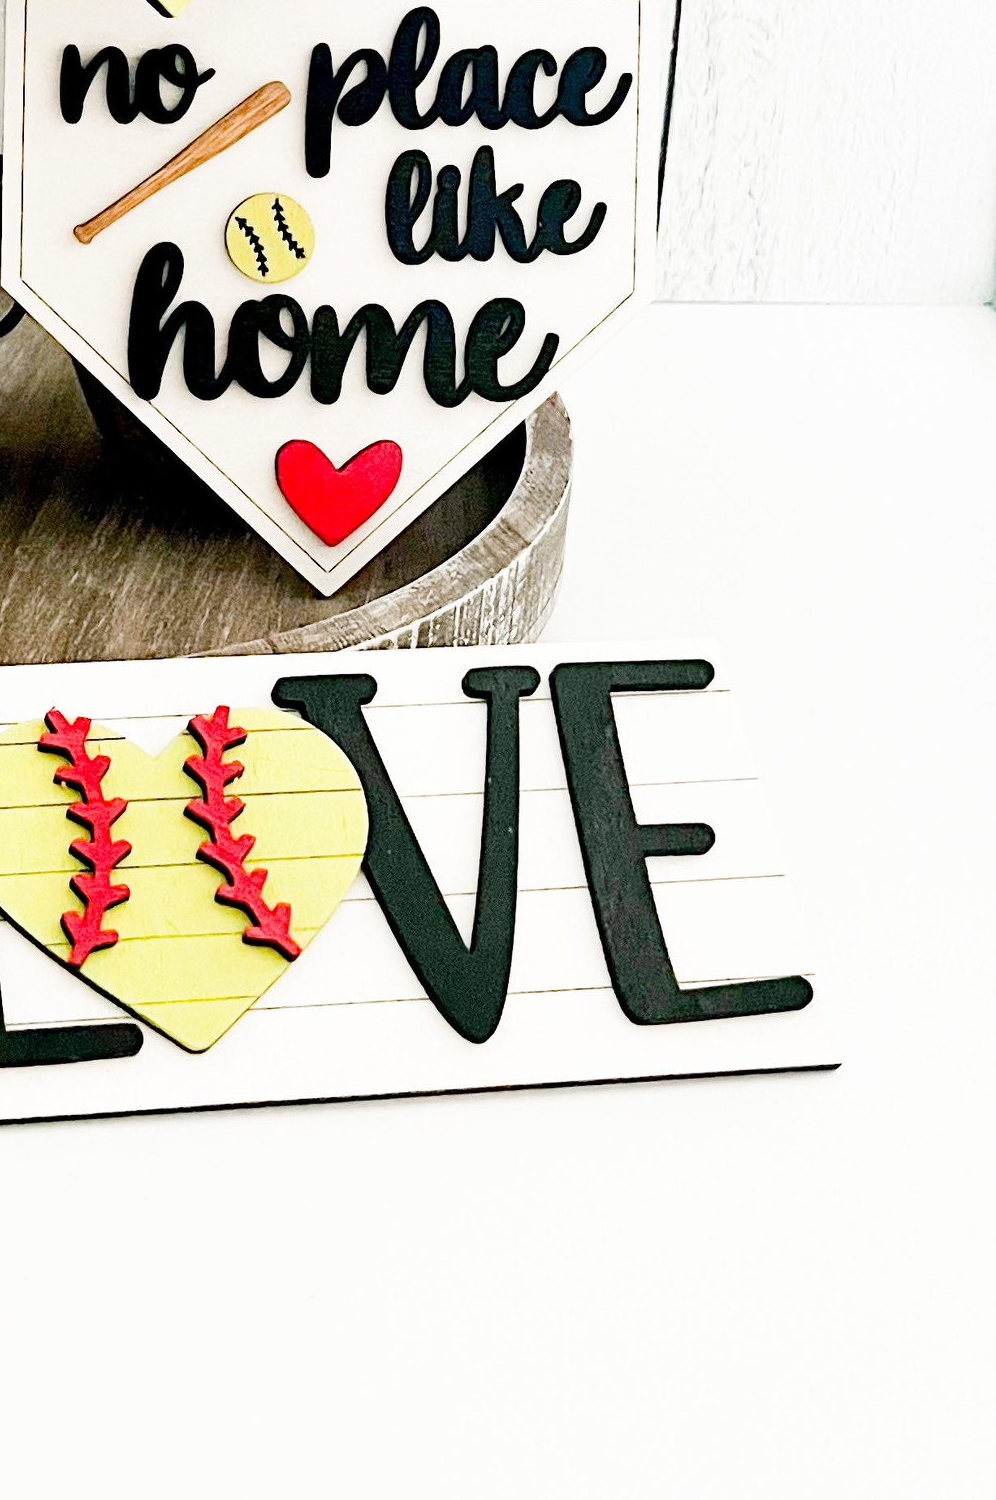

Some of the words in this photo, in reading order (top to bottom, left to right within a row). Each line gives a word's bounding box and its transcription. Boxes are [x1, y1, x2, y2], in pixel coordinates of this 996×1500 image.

[59, 42, 216, 125] no
[304, 6, 633, 179] place
[385, 144, 608, 266] like
[127, 241, 560, 408] home
